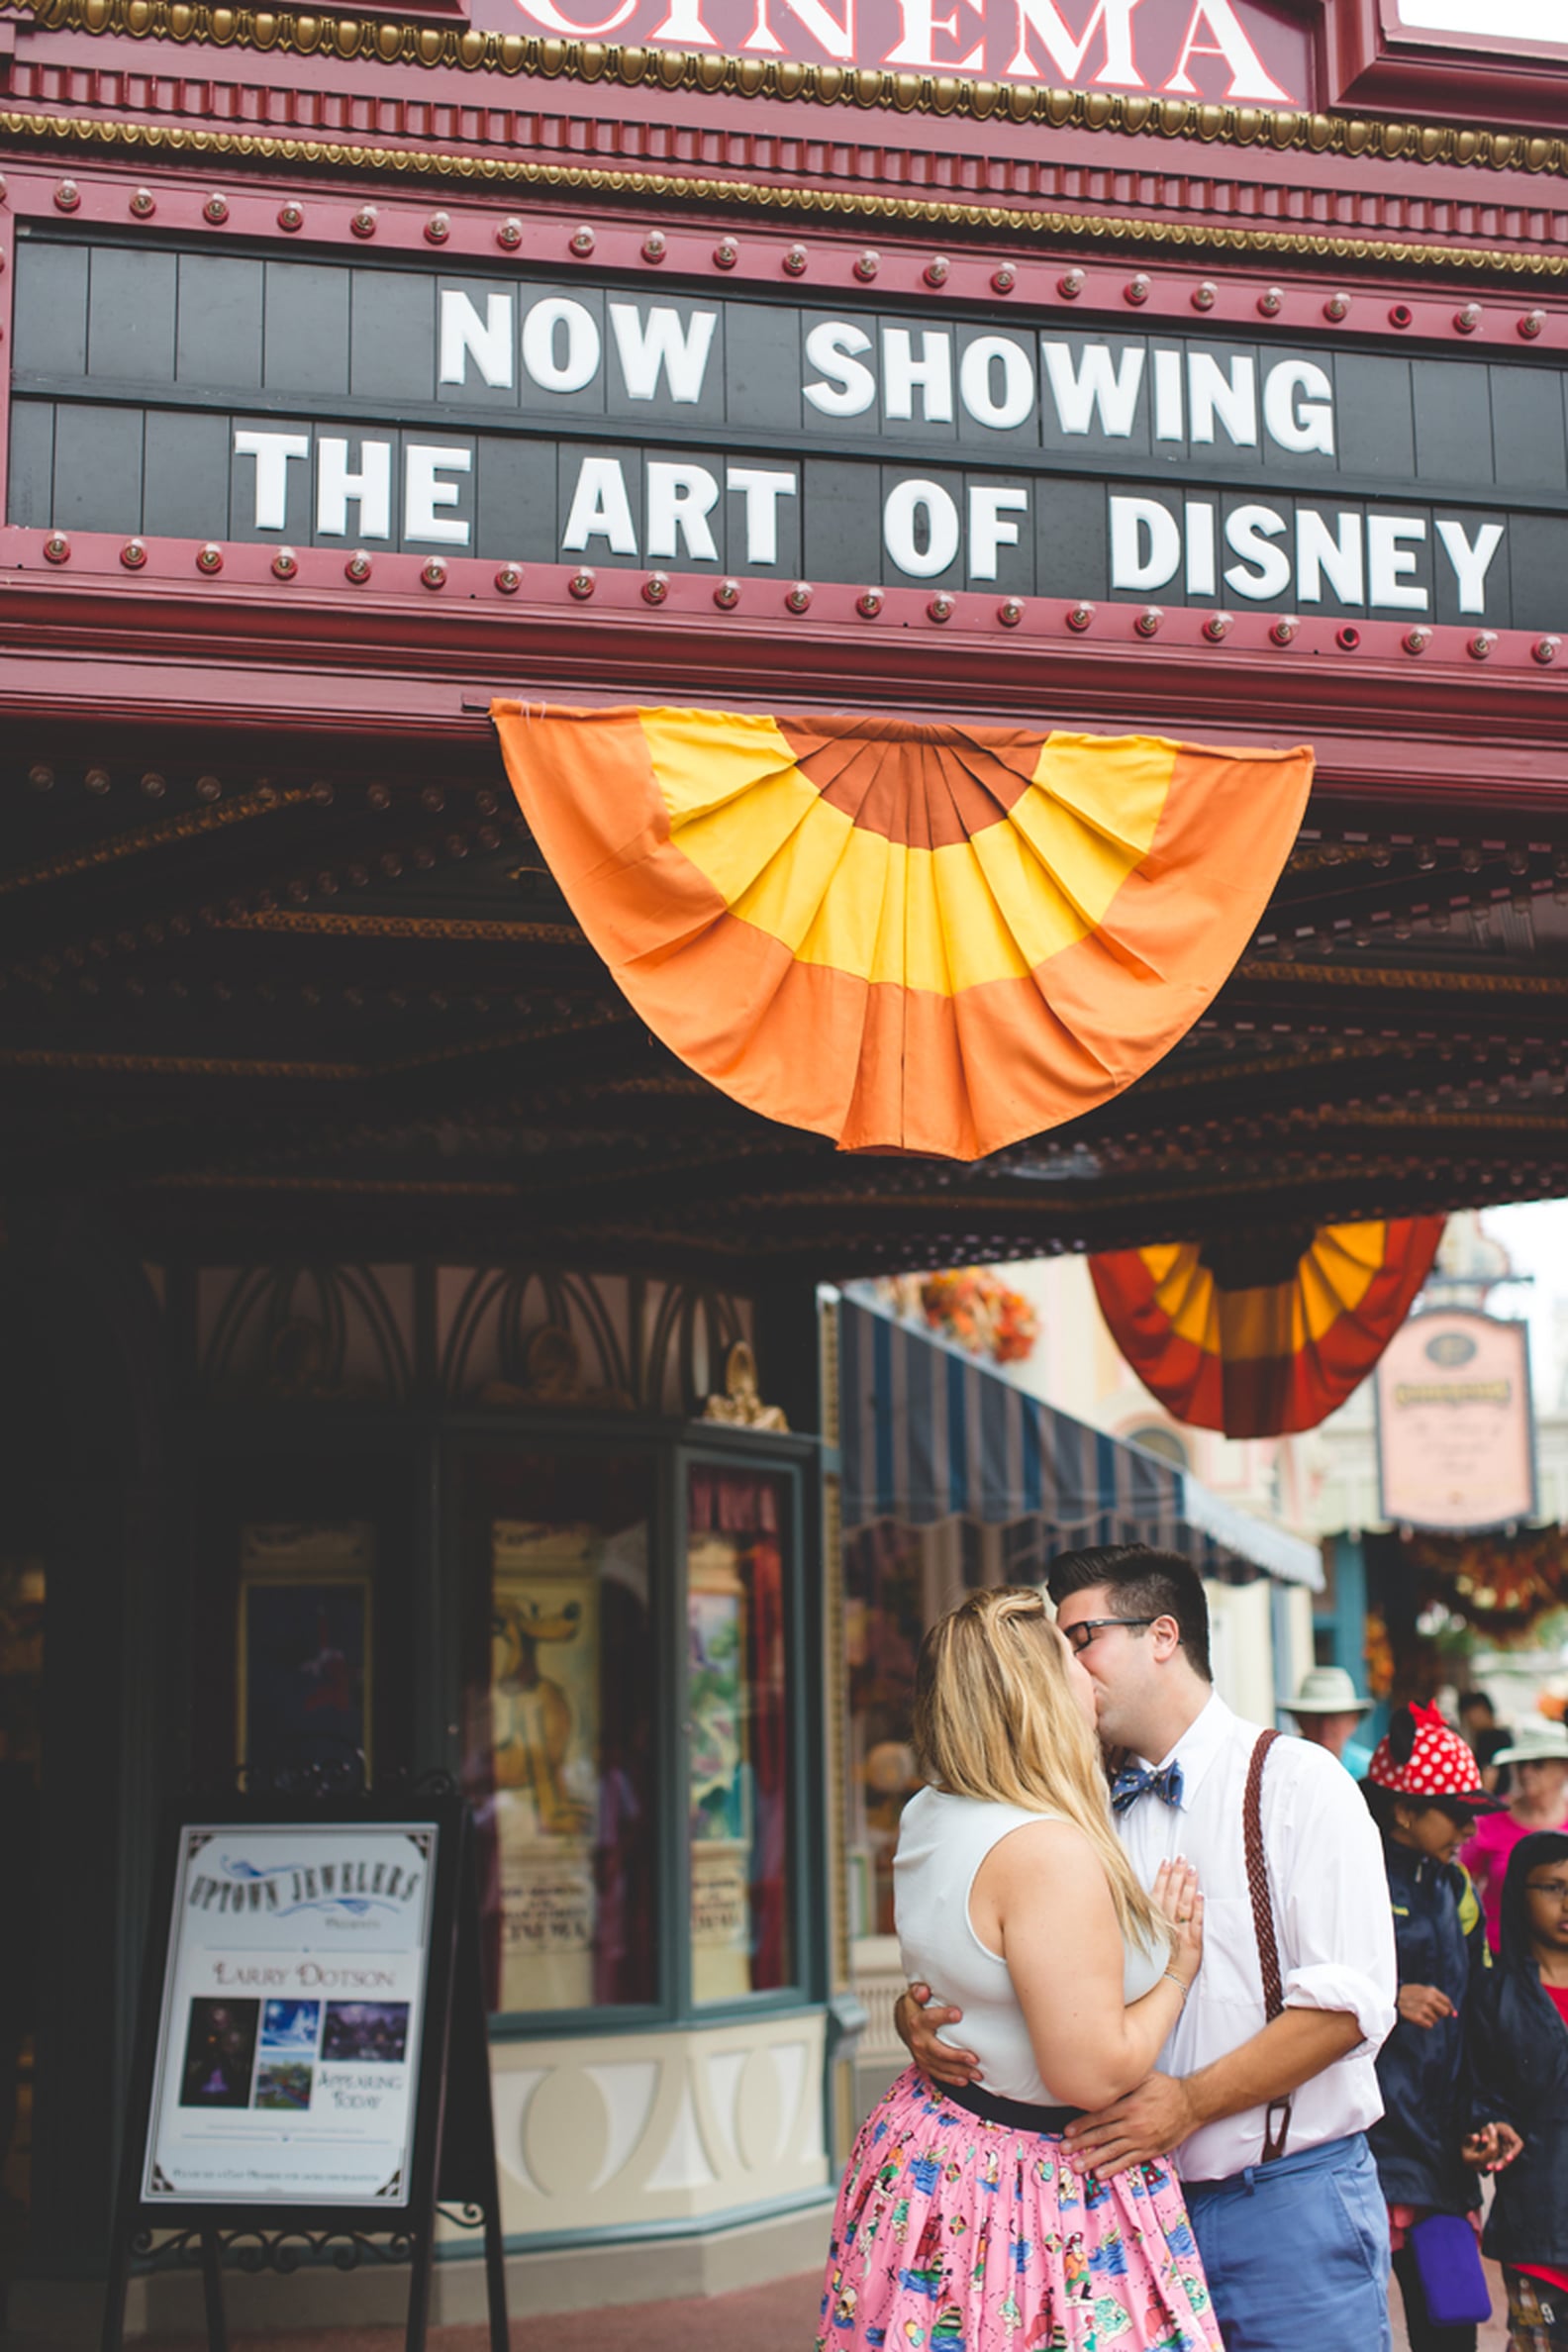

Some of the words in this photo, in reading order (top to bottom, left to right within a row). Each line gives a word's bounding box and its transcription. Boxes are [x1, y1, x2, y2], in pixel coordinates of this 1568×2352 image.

[438, 289, 719, 404] NOW
[800, 320, 1336, 456] SHOWING
[234, 430, 473, 546] THE
[561, 455, 797, 564] ART
[883, 478, 1029, 581] OF
[1109, 494, 1506, 615] DISNEY
[188, 1875, 280, 1914] UPTOWN
[291, 1860, 420, 1903] JEWELERS
[213, 1960, 289, 1988] LARRY
[295, 1961, 397, 1989] DOTSON
